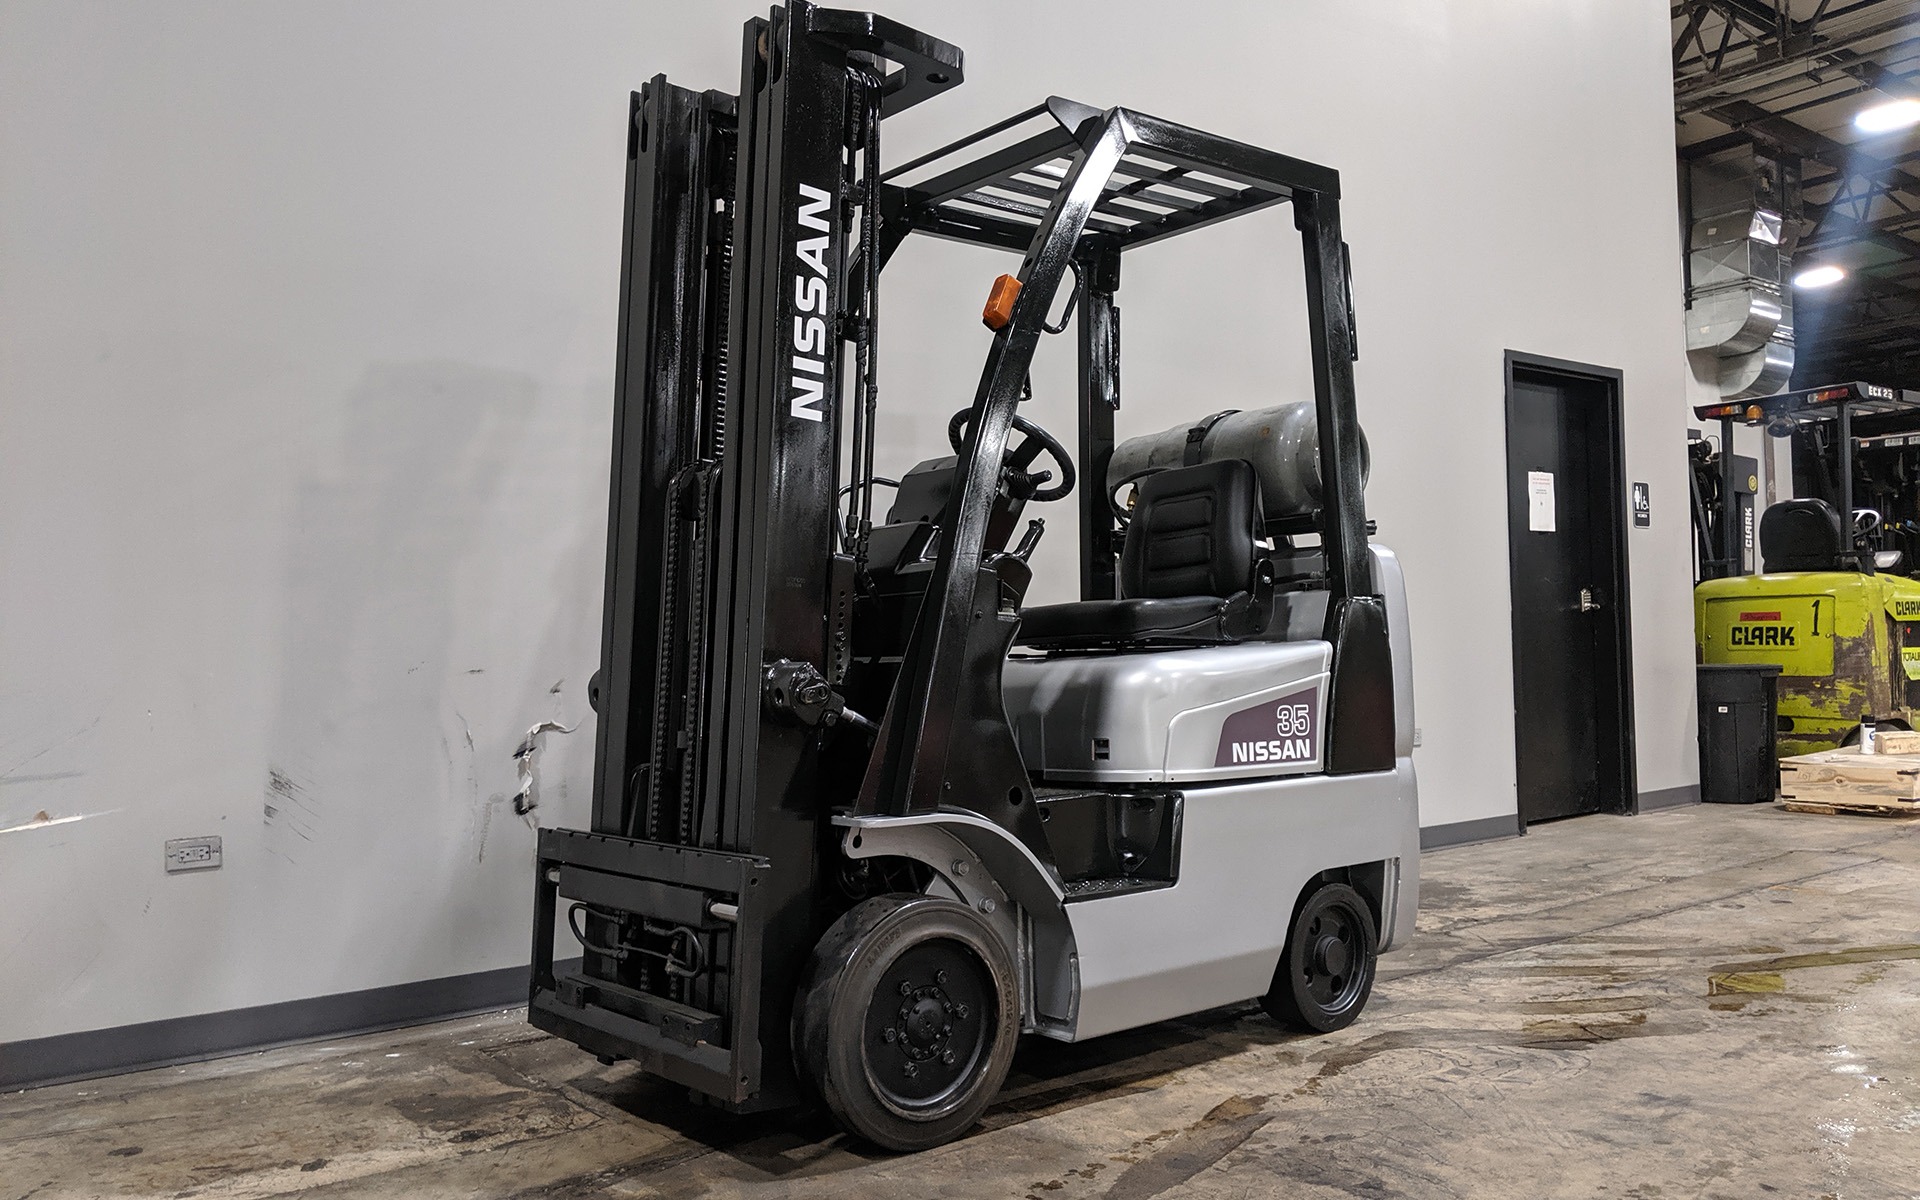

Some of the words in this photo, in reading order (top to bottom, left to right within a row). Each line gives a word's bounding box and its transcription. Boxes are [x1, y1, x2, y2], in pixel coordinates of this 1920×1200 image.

[791, 183, 832, 422] NISSAN
[1811, 599, 1820, 636] 1
[1731, 626, 1795, 646] CLARK
[1276, 704, 1310, 737] 35
[1232, 739, 1311, 763] NISSAN
